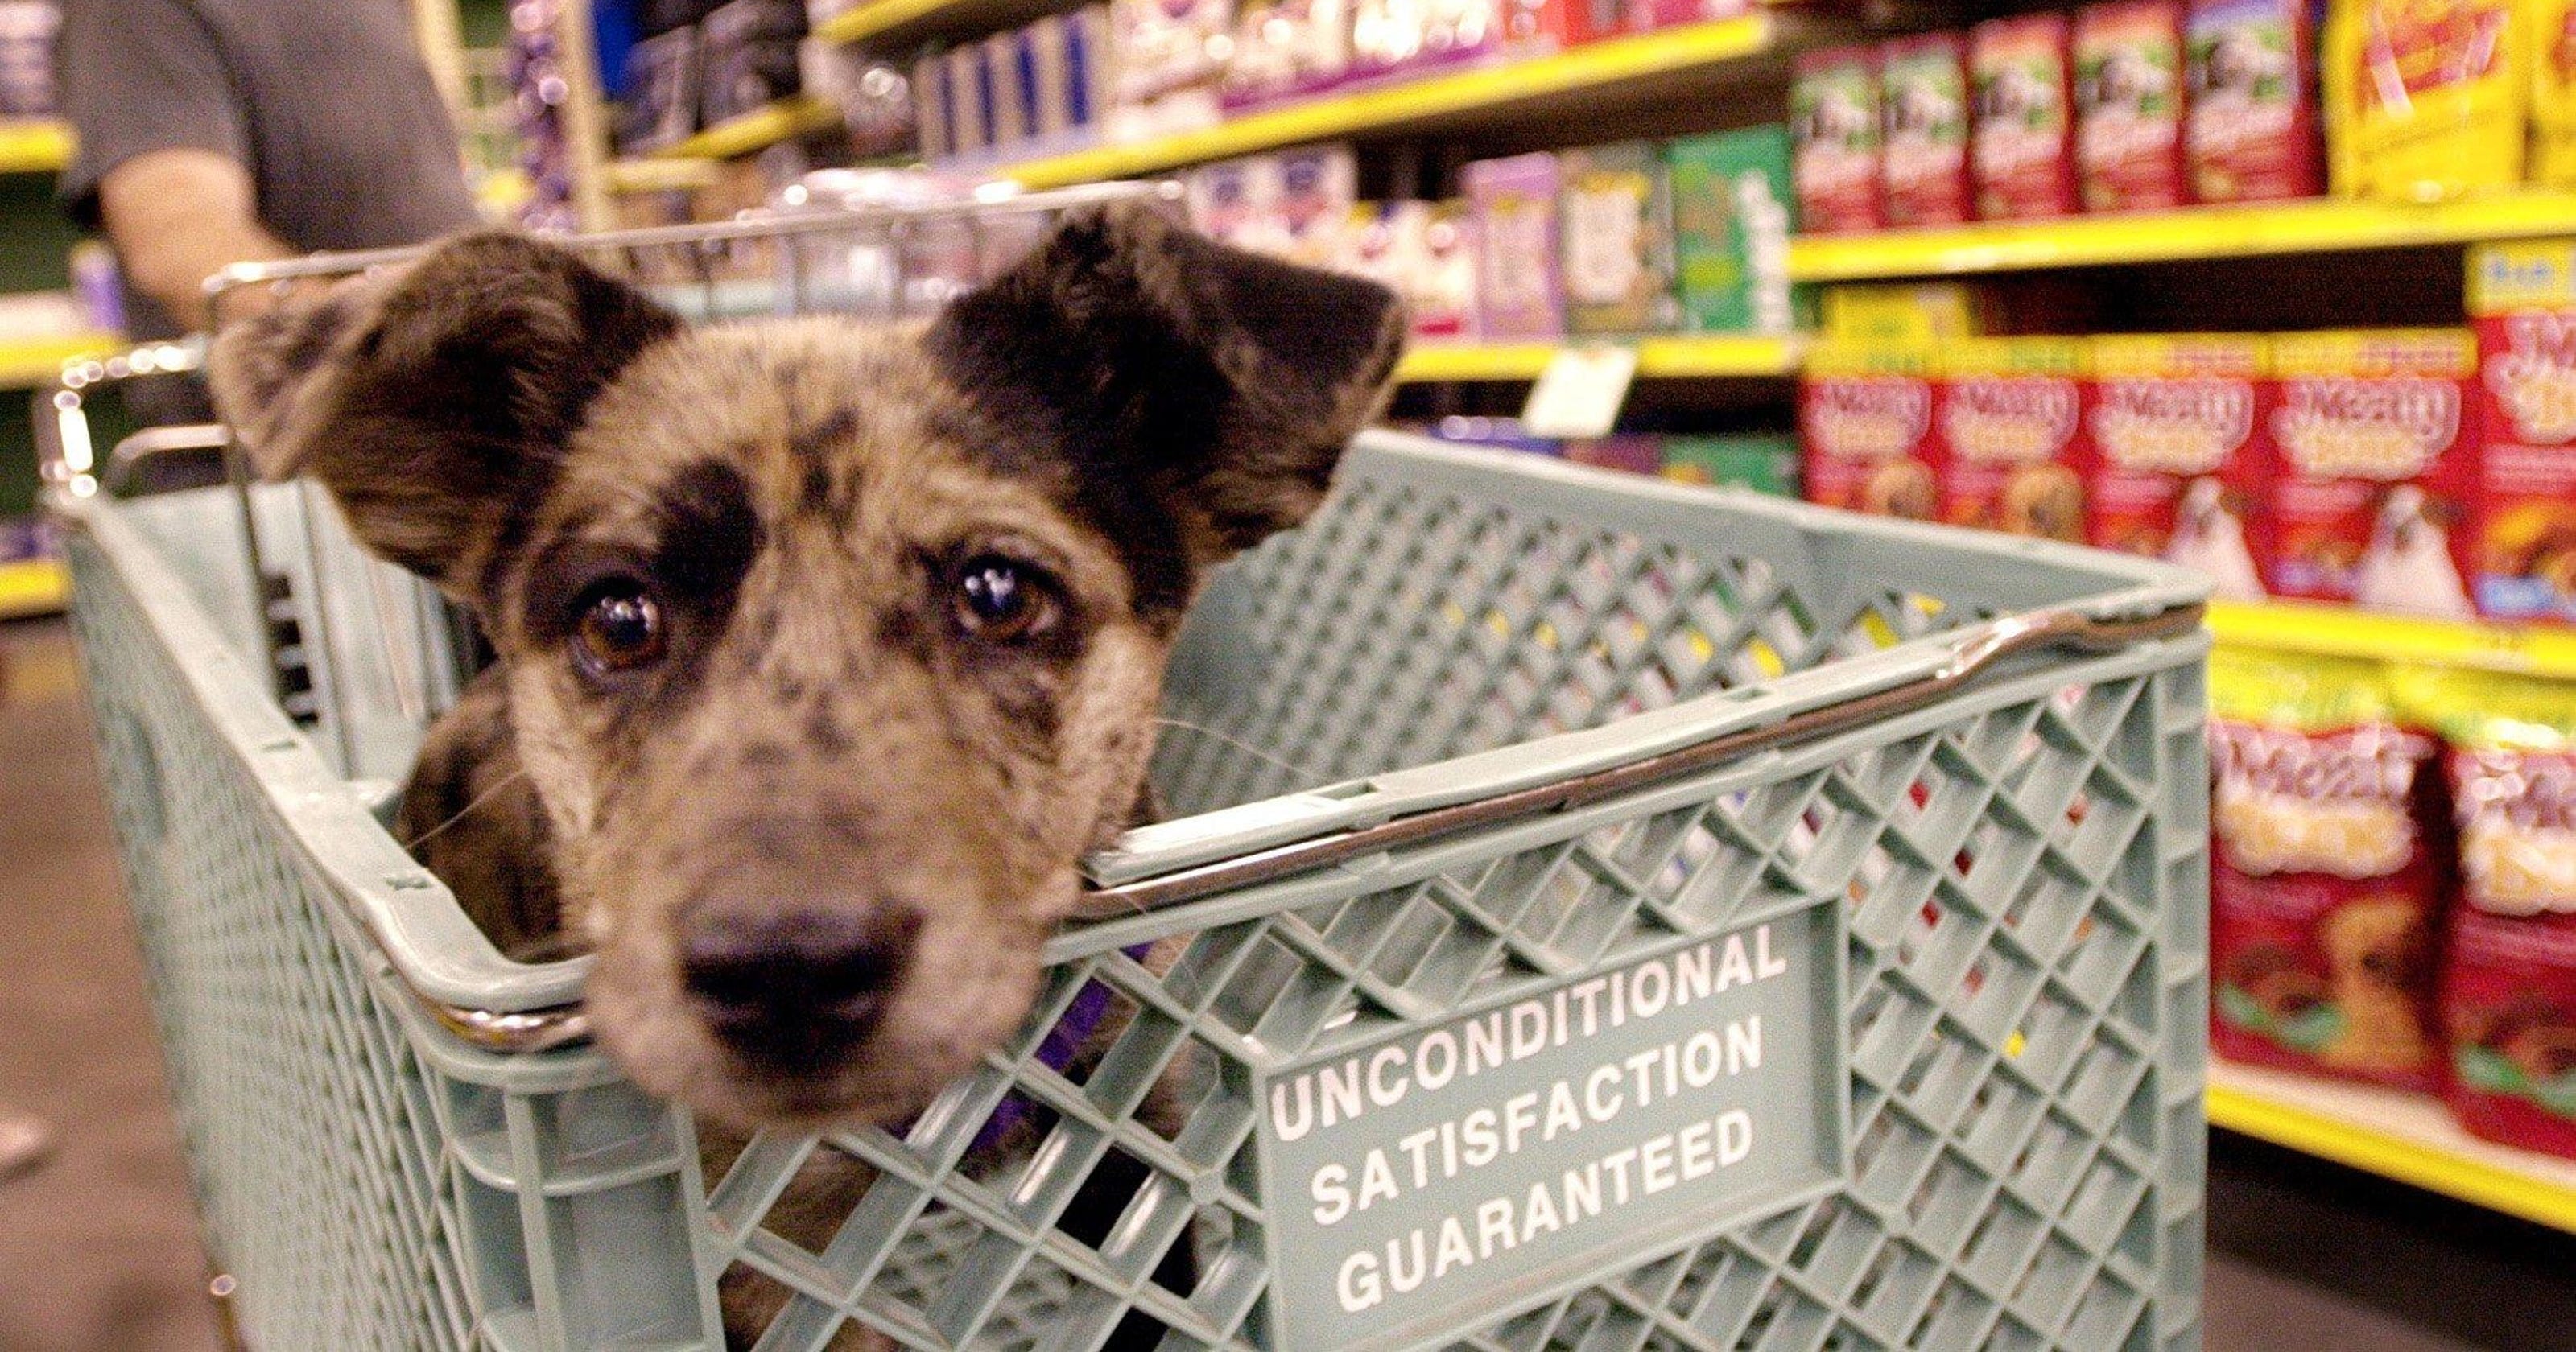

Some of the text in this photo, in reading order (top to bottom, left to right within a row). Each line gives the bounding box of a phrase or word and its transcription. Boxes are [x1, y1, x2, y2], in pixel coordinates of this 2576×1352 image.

[2289, 378, 2444, 438] Meaty
[1270, 924, 1787, 1142] UNCONDITIONAL
[1311, 1015, 1764, 1226] SATISFACTION
[1337, 1109, 1752, 1313] GUARANTEED
